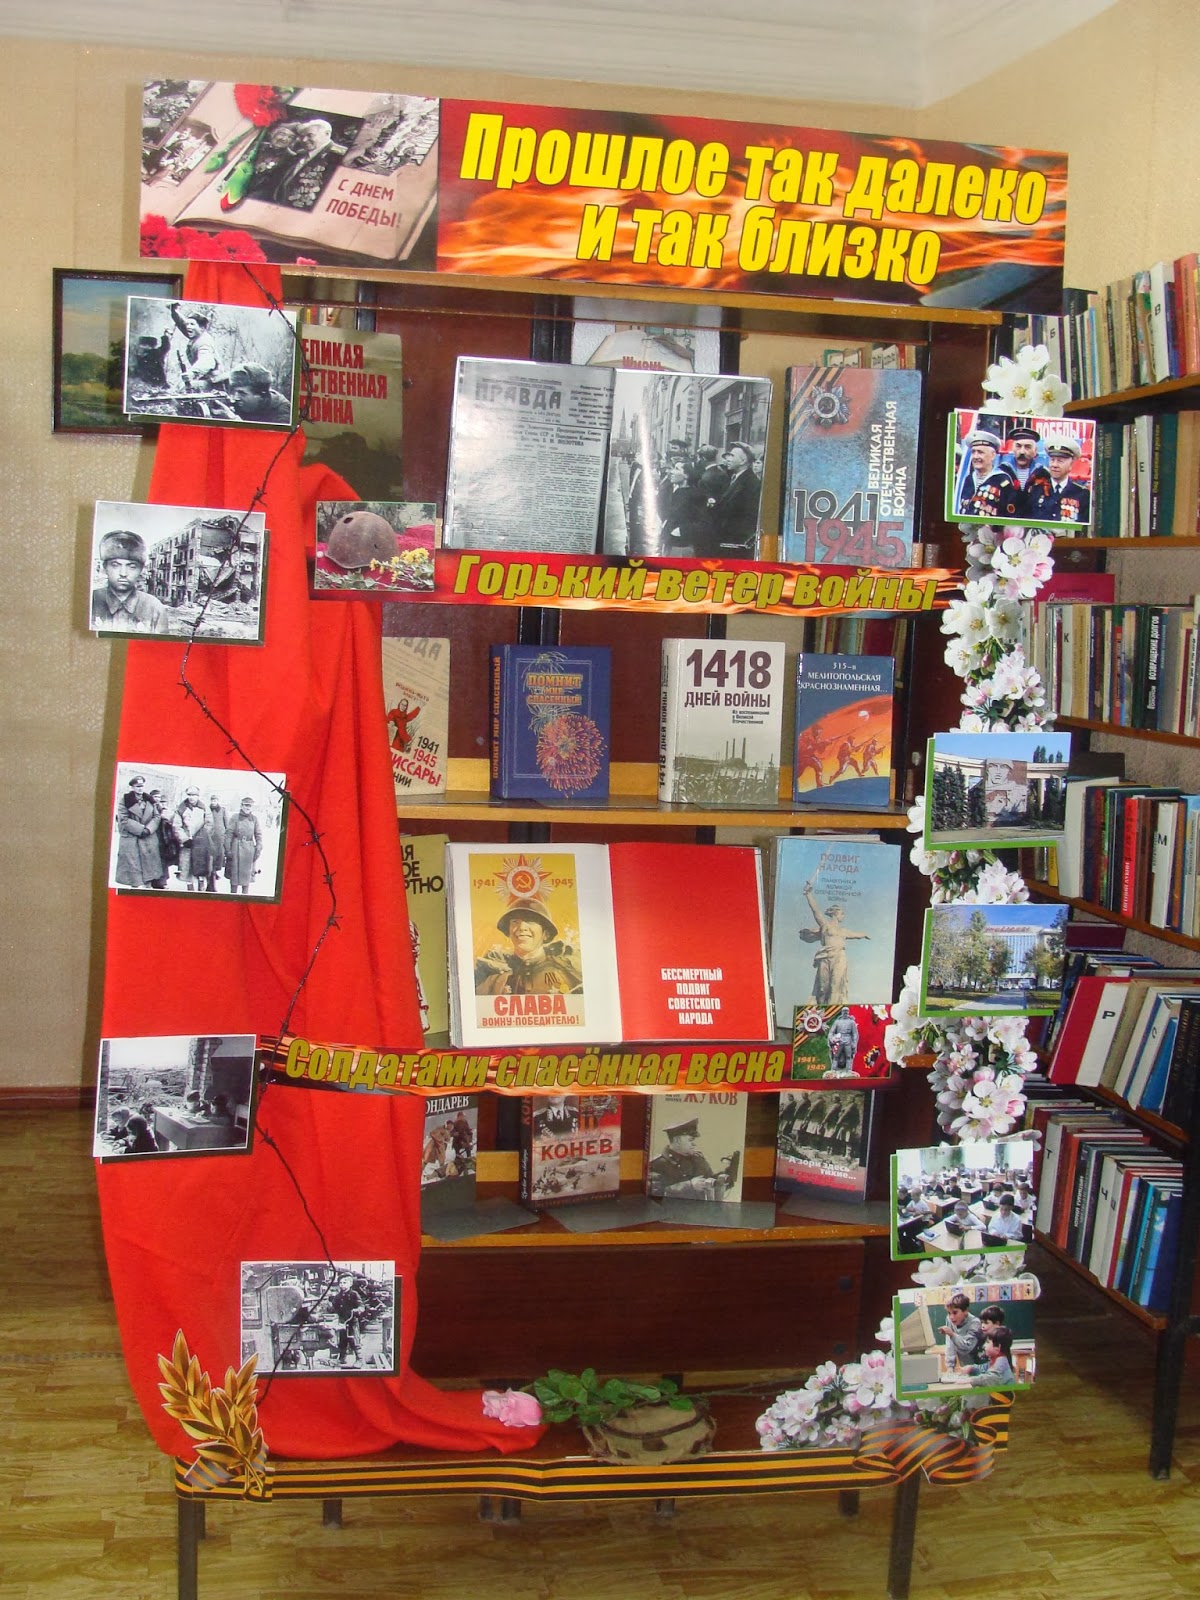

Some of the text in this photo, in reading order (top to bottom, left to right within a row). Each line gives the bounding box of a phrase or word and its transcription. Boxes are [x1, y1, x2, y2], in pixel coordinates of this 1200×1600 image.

[459, 112, 1047, 225] Прошлое так далеко
[338, 179, 394, 201] С ДНЕМ
[326, 198, 402, 228] ПОБЕДЫ!
[576, 204, 941, 285] и так близко
[475, 382, 562, 410] ПРАВДА
[868, 424, 882, 489] ВЕЛИКАЯ
[880, 401, 897, 516] ОТЕЧЕСТВЕННАЯ
[893, 466, 907, 516] ВОЙНА
[793, 489, 880, 537] 1941
[804, 517, 906, 567] 1945
[453, 554, 938, 611] Горький ветер войны
[1151, 616, 1160, 636] ДОЛГОВ
[1149, 635, 1158, 681] ВОЗВРАЩЕНИЕ
[686, 649, 772, 689] 1418
[807, 672, 881, 681] МЕЛИТОПОЛЬСКАЯ
[528, 674, 582, 688] ПОМНИТ
[528, 694, 582, 705] СПАСЕННЫЙ
[544, 687, 563, 696] МИР
[684, 690, 771, 708] ДНЕЙ ВОЙНЫ
[417, 736, 439, 754] 1941
[413, 748, 437, 767] 1945
[820, 853, 860, 863] ПОДВИГ
[820, 863, 859, 874] НАРОДА
[473, 878, 495, 888] 1941
[551, 878, 573, 889] 1945
[661, 967, 723, 981] БЕССМЕРТНЫЙ
[676, 982, 710, 996] ПОДВИГ
[493, 994, 567, 1016] СЛАВА
[668, 997, 721, 1010] СОВЕТСКОГО
[678, 1012, 714, 1025] НАРОДА
[286, 1039, 786, 1090] Солдатами спасённая весна
[541, 1138, 613, 1162] КОНЕВ
[797, 1159, 821, 1167] зори
[822, 1162, 850, 1172] здесь
